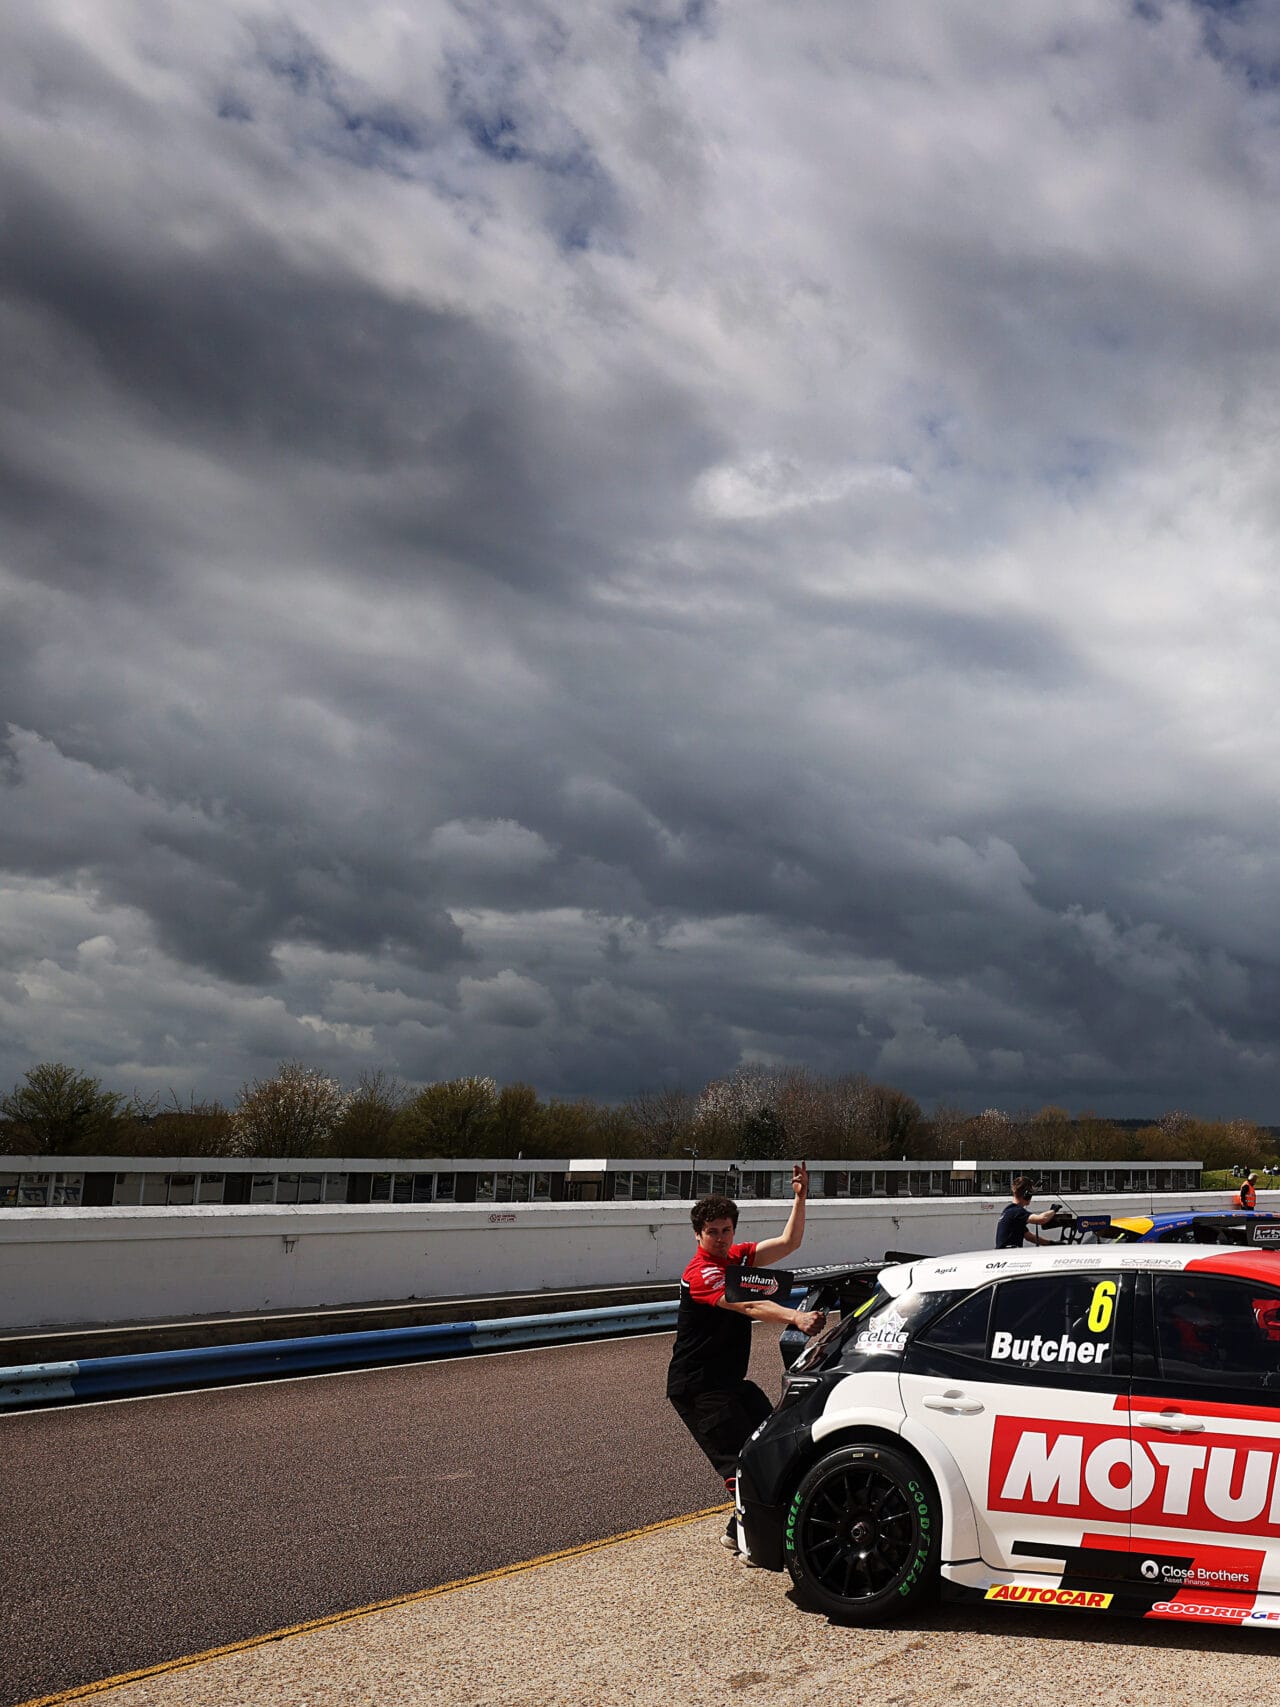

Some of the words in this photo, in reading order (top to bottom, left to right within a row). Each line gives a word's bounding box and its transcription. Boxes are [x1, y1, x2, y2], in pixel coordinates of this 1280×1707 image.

[741, 1275, 774, 1285] witham
[1087, 1281, 1117, 1333] 6
[991, 1332, 1110, 1364] Butcher
[786, 1490, 803, 1550] EAGLE
[1161, 1566, 1194, 1579] Close
[1197, 1568, 1249, 1583] Brothers
[1184, 1578, 1210, 1586] Finance
[995, 1585, 1106, 1608] AUTOCAR
[1152, 1602, 1280, 1621] GOODRIDGE
